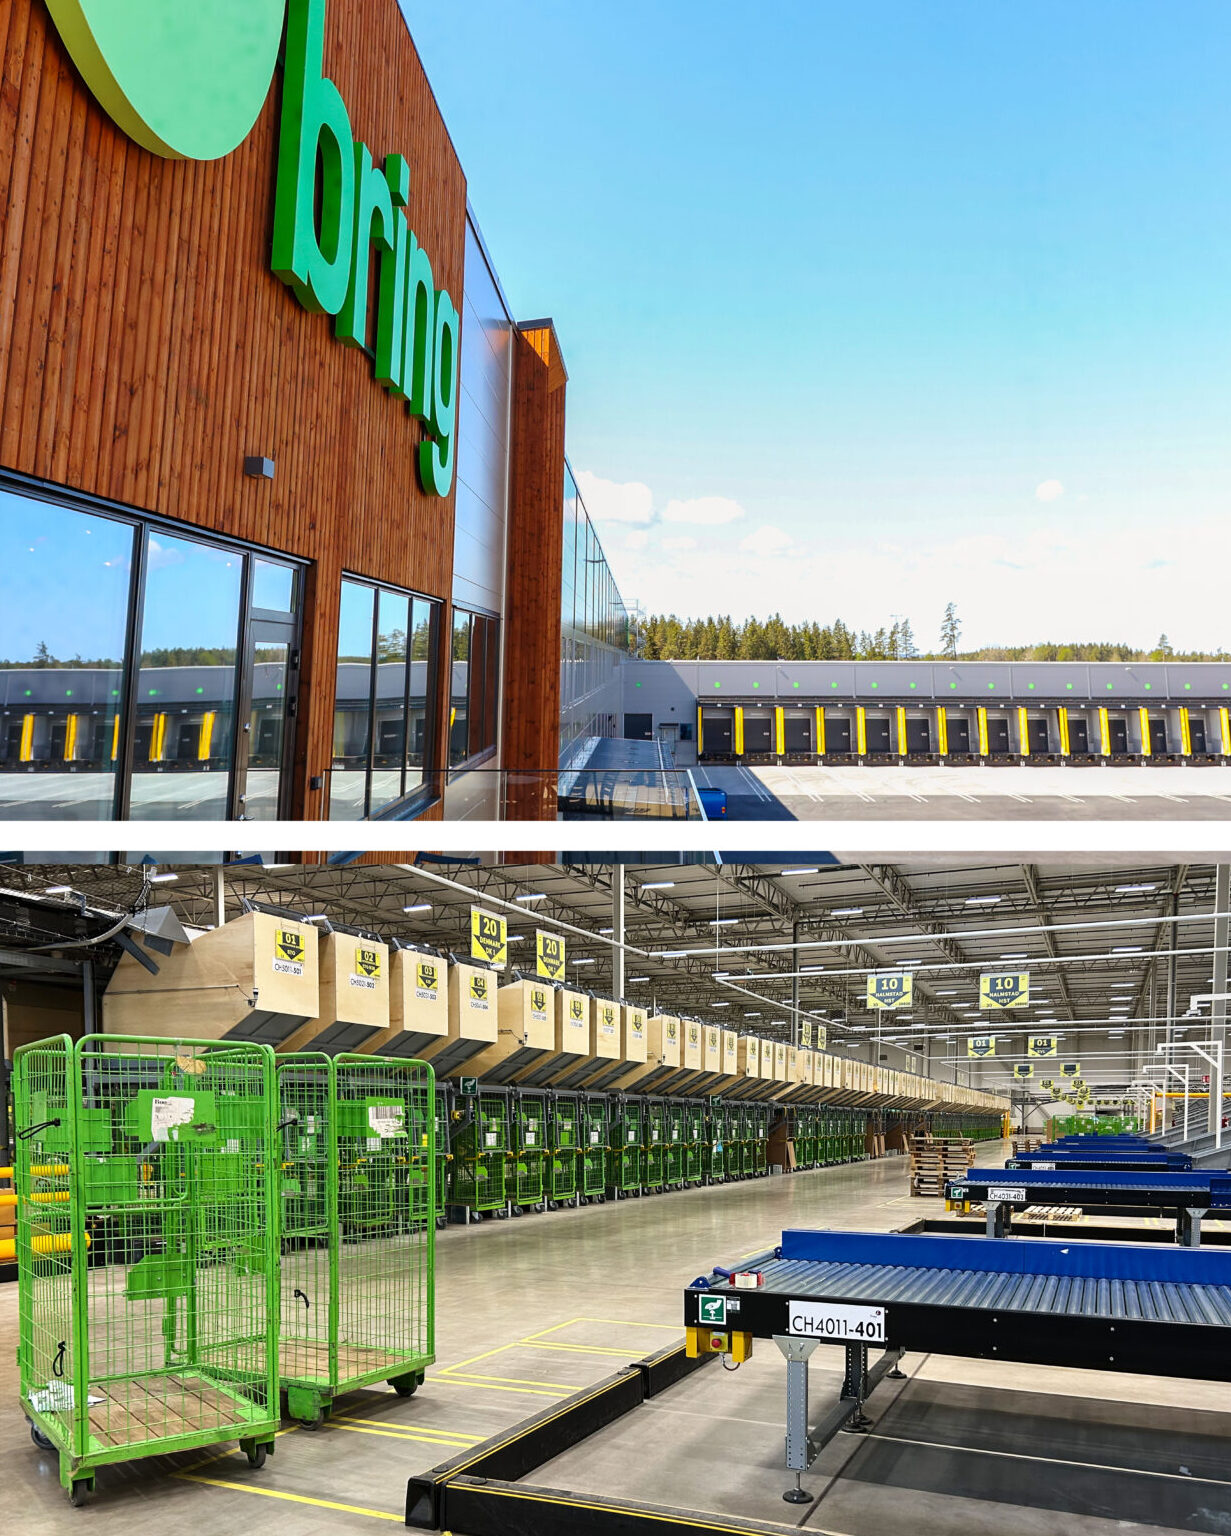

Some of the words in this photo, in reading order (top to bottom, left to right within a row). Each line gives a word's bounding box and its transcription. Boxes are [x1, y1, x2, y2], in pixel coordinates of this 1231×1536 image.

[271, 0, 459, 498] bring
[483, 918, 497, 937] 20
[285, 933, 297, 945] 01
[479, 936, 501, 949] DENMARK
[545, 939, 557, 956] 20
[364, 951, 374, 962] 02
[424, 965, 433, 976] 03
[881, 978, 898, 990] 10
[995, 977, 1014, 990] 10
[989, 990, 1020, 998] HALMSTAD
[975, 1039, 987, 1047] 01
[1036, 1039, 1048, 1047] 01
[791, 1314, 882, 1339] CH4011-401
